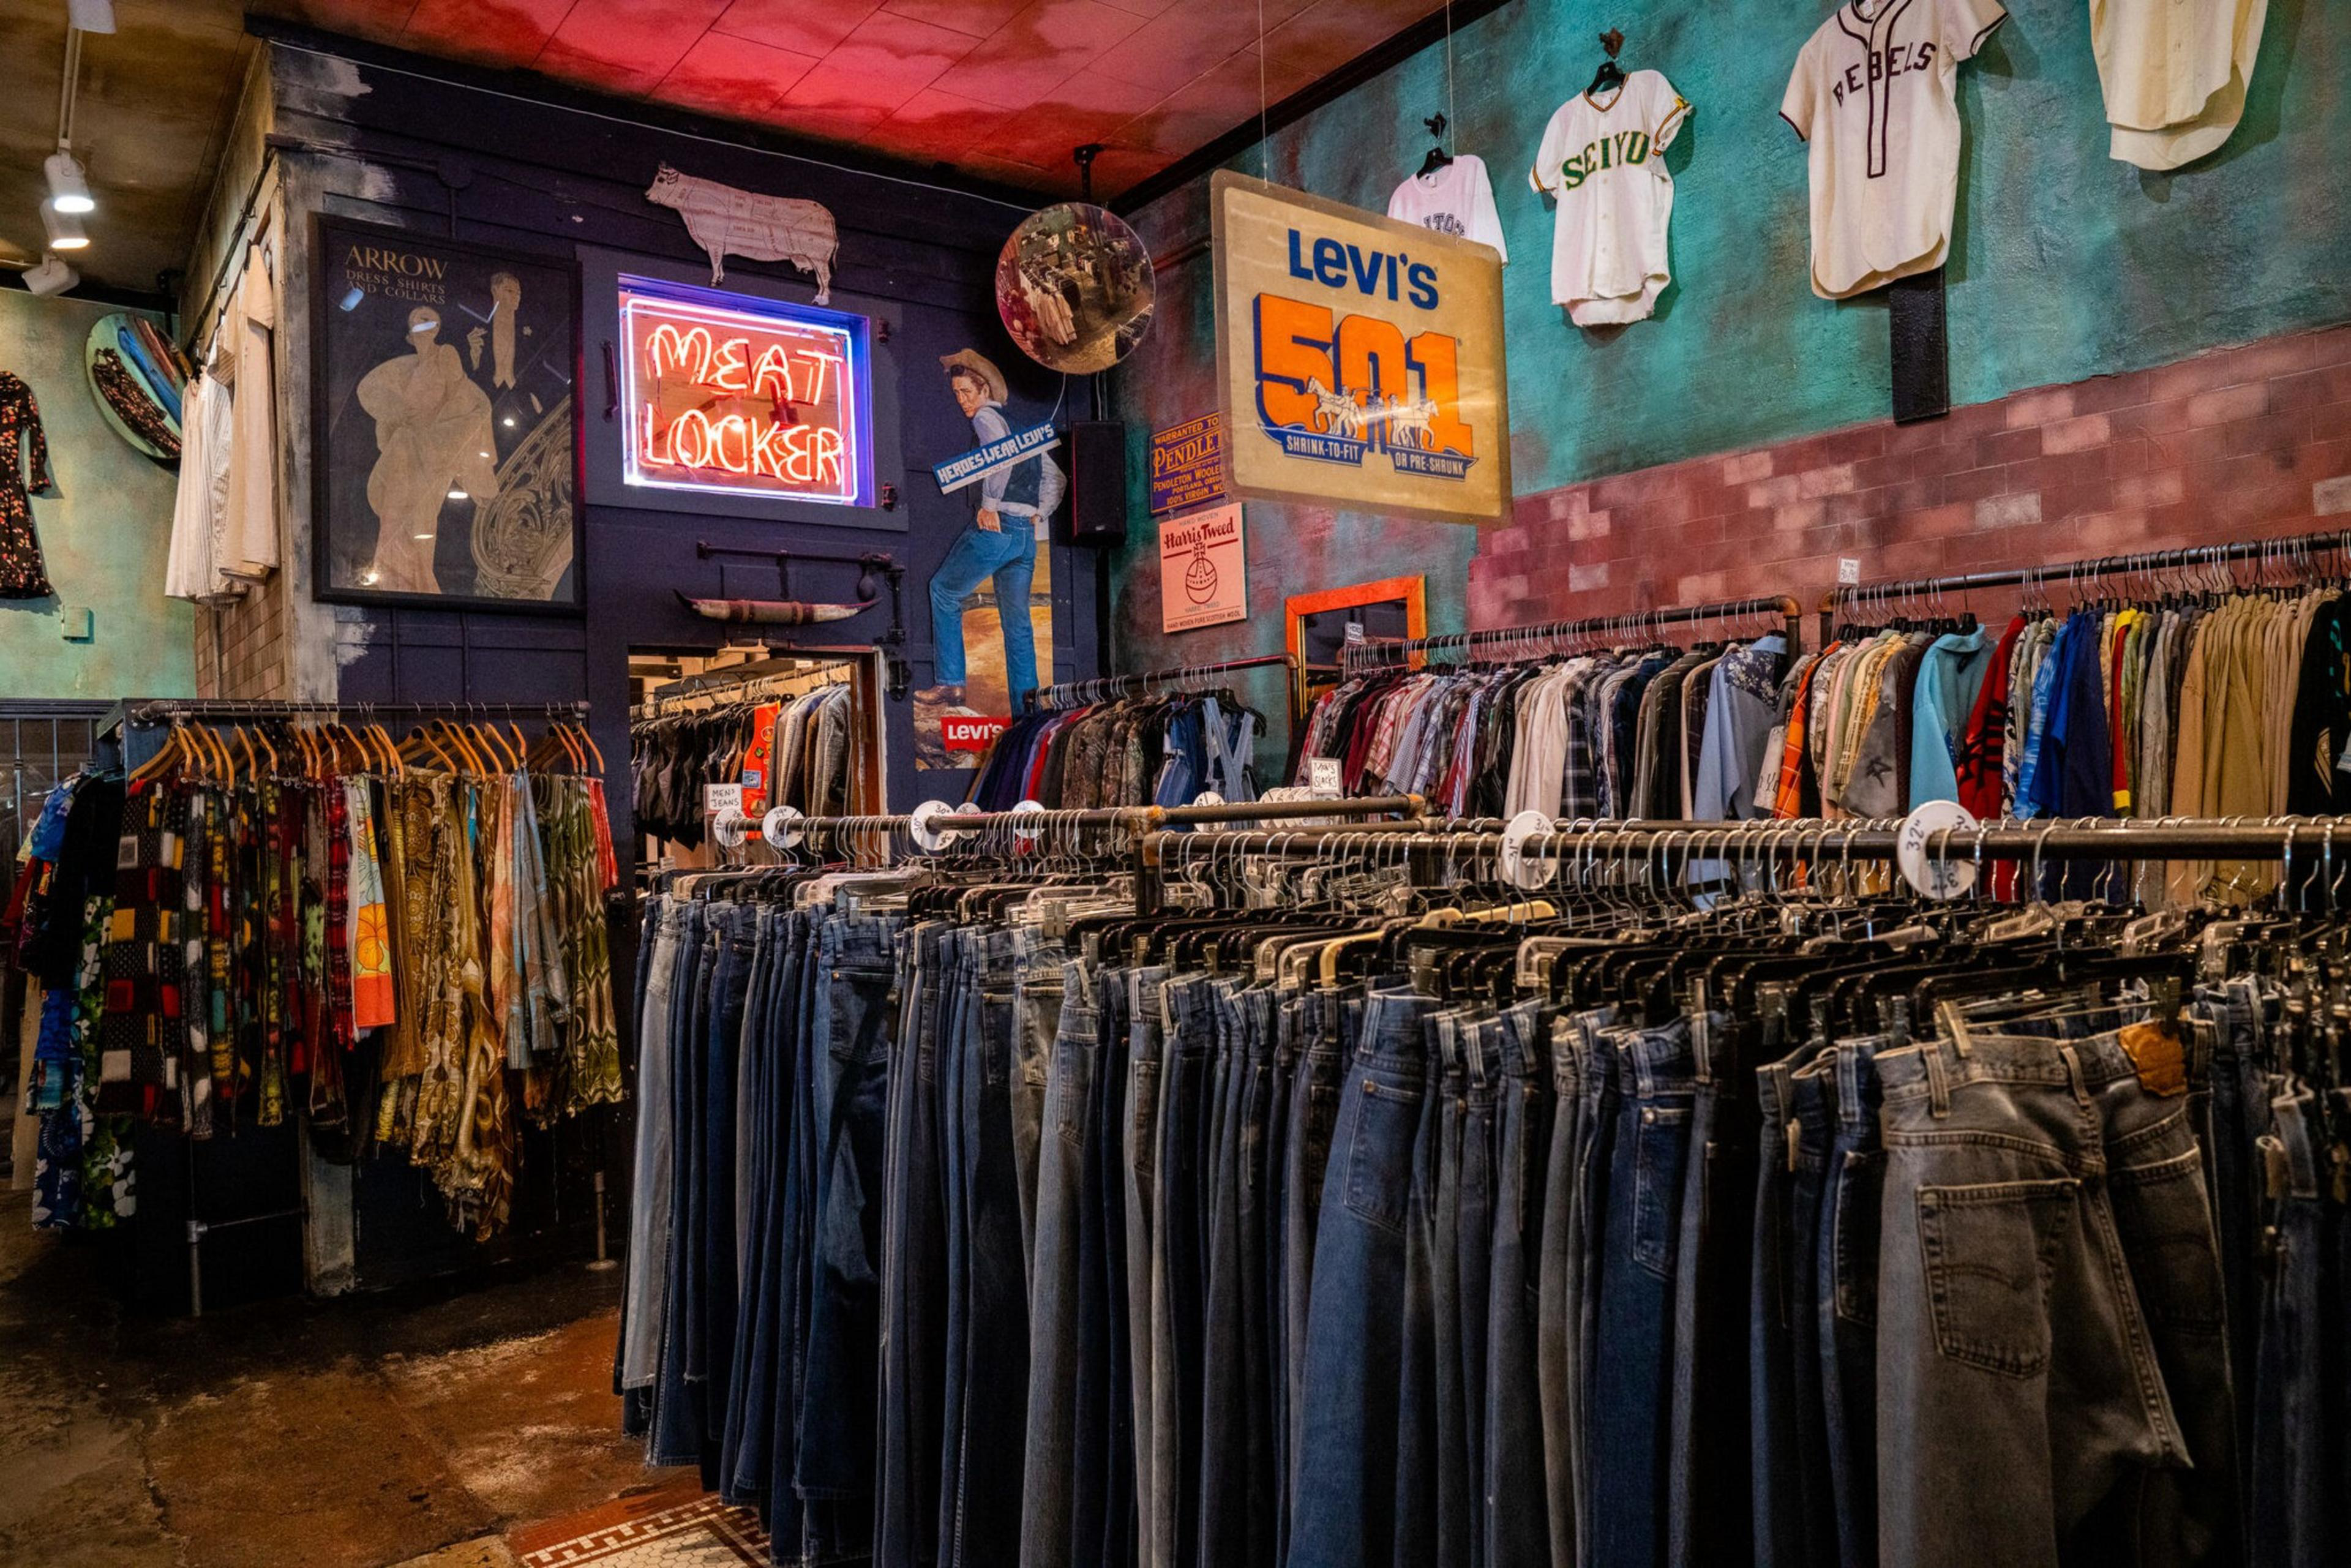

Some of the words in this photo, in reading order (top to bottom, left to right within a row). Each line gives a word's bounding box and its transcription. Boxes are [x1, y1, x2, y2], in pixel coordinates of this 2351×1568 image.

[1833, 42, 1937, 109] REBELS
[1561, 130, 1651, 192] SEIYU
[345, 245, 448, 280] ARROW
[347, 269, 389, 285] DRESS
[397, 277, 446, 294] SHIRTS
[384, 287, 446, 305] COLLARS
[654, 323, 843, 406] MEAT
[1253, 292, 1472, 457] 501
[647, 402, 842, 485] LOCKER
[1155, 422, 1203, 445] WARRANTED
[1207, 417, 1219, 428] TO
[937, 452, 985, 484] HEROES
[981, 438, 1019, 464] WEAR
[1286, 435, 1359, 460] SHRINK-TO-FIT
[1395, 452, 1408, 467] OR
[1410, 454, 1464, 476] PRE-SHRUNK
[1153, 473, 1192, 492] PENDLETON
[1185, 487, 1210, 501] VIRGIN
[1164, 527, 1201, 550] Harris
[1201, 516, 1235, 540] Tweed
[711, 798, 740, 807] JEANS
